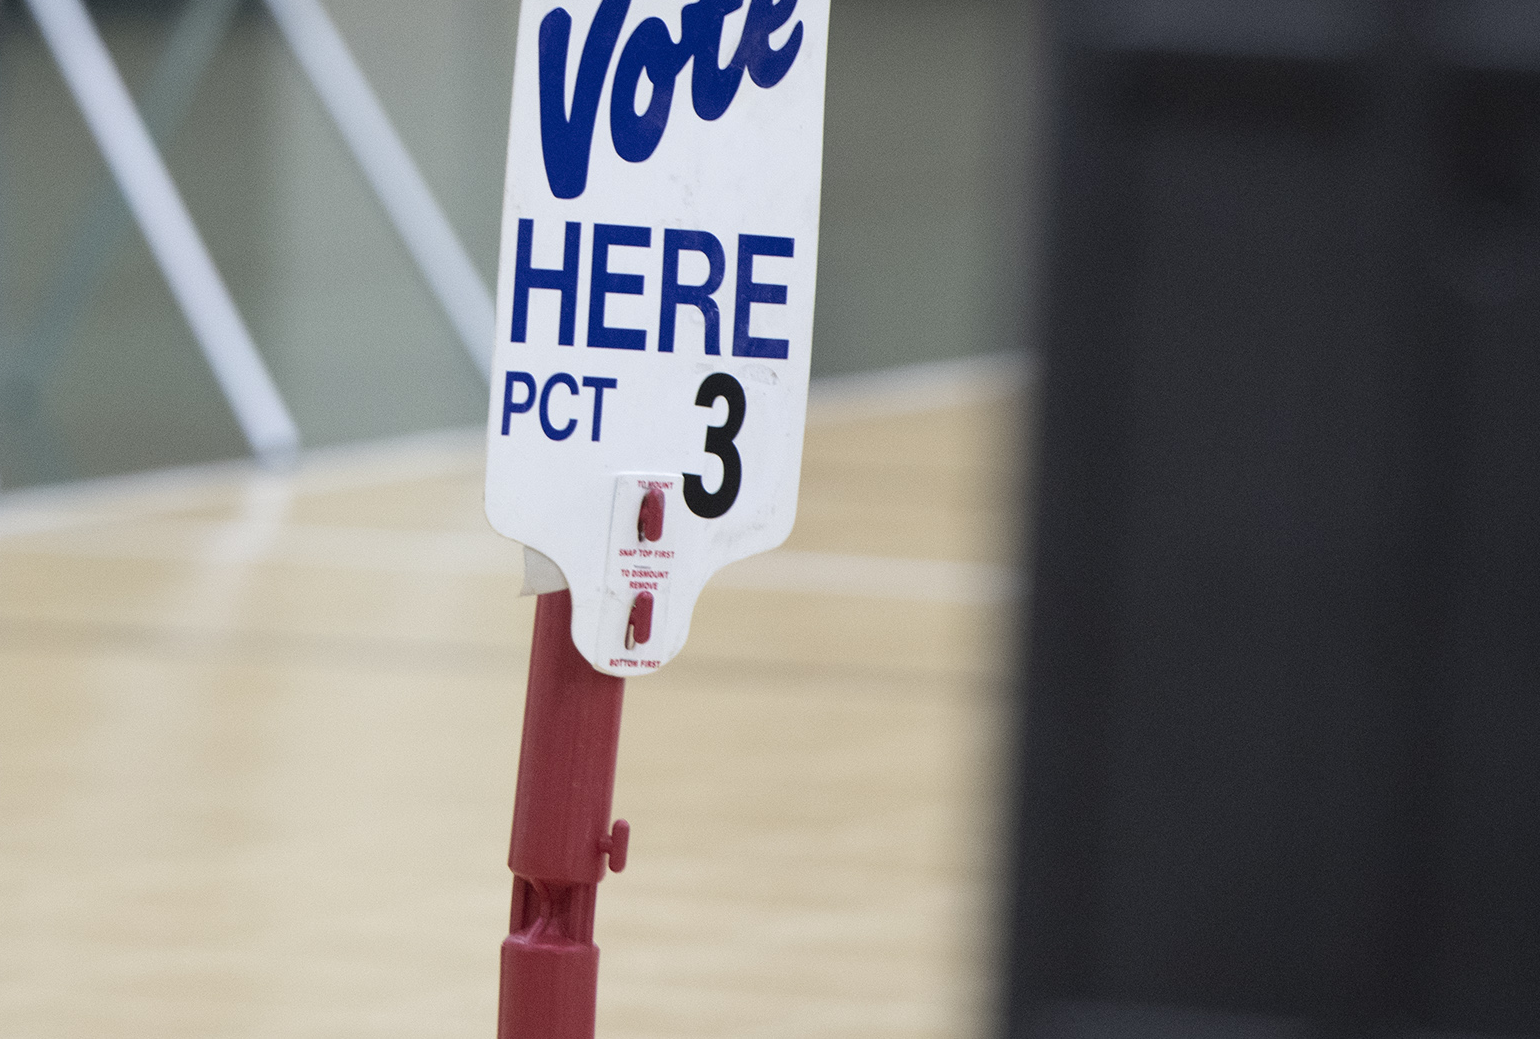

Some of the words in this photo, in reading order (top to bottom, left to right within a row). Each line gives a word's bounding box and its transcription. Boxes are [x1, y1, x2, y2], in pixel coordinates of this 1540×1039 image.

[510, 218, 795, 360] HERE
[501, 371, 617, 443] PCT
[681, 372, 747, 519] 3
[637, 480, 647, 488] TO
[648, 481, 673, 489] MOUNT
[654, 550, 674, 558] FIRST
[621, 569, 630, 577] TO
[632, 570, 668, 578] DISMOUNT
[629, 581, 658, 589] REMOVE
[610, 659, 638, 667] BOTTOM
[640, 660, 660, 668] FIRST
